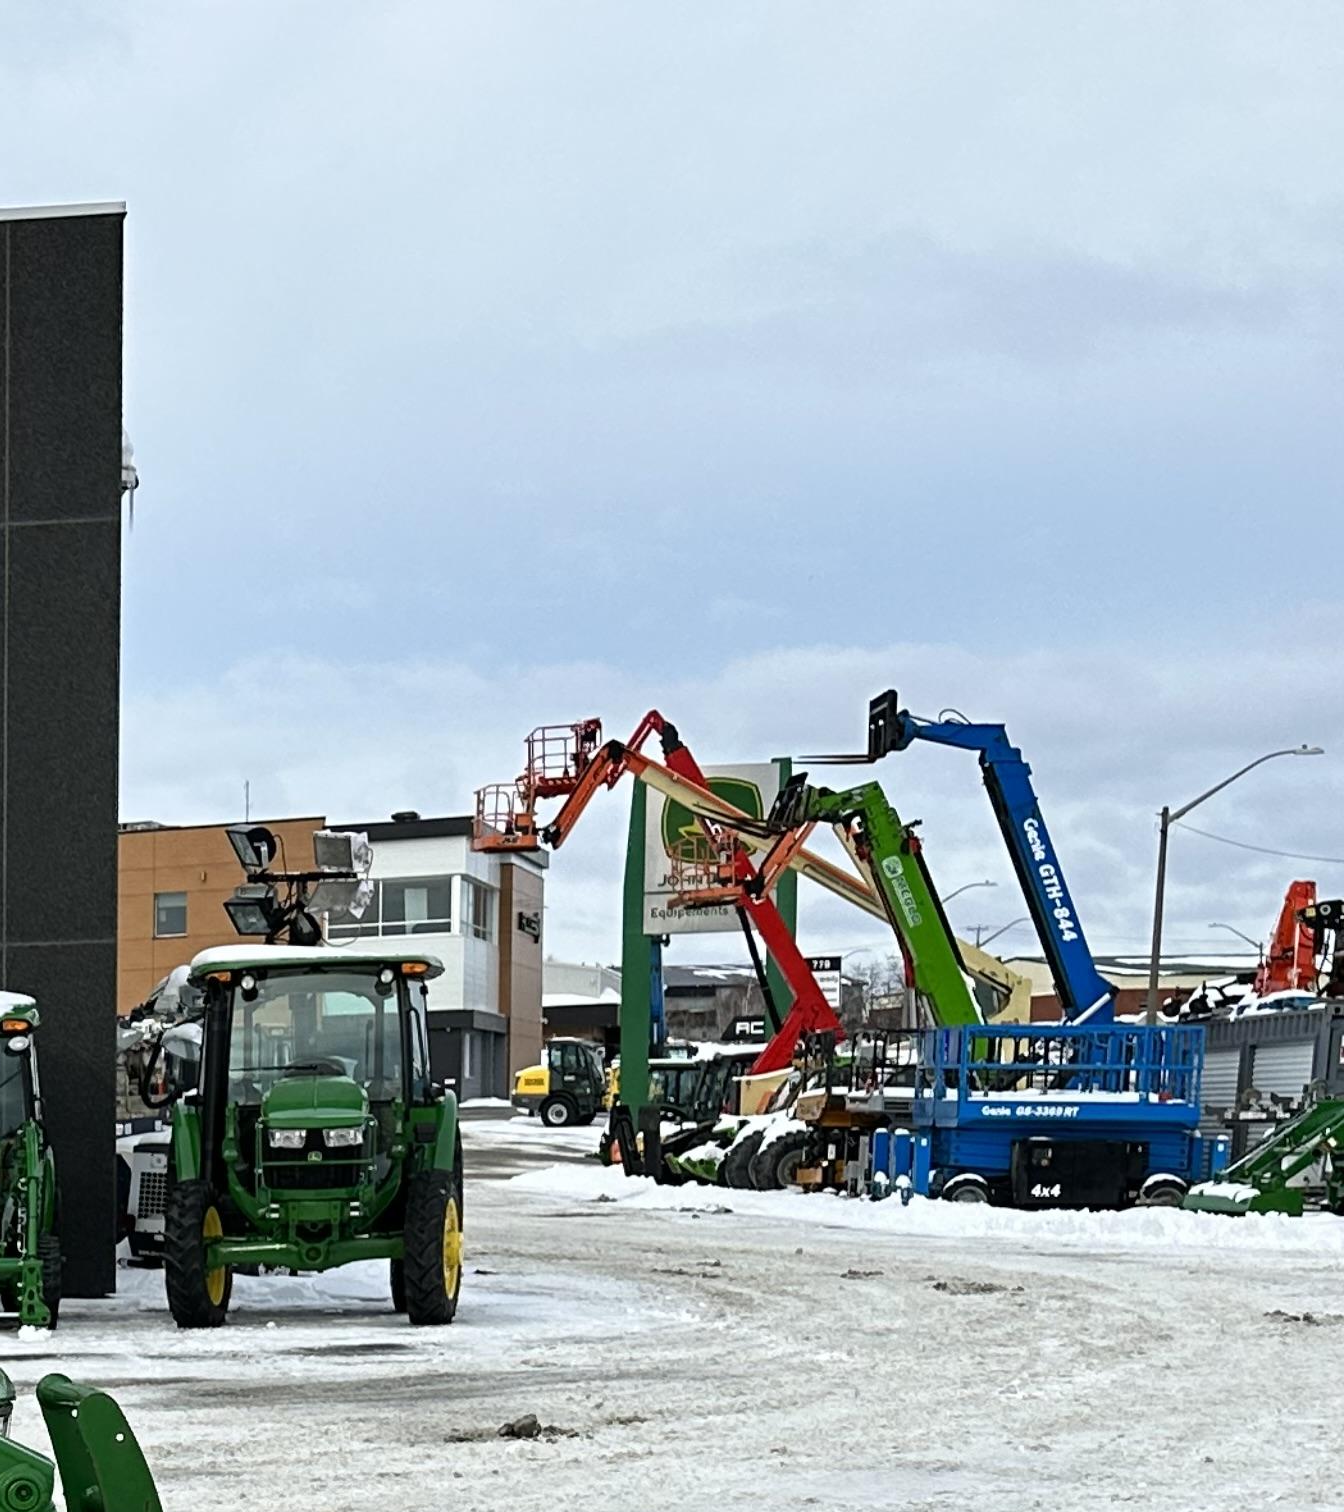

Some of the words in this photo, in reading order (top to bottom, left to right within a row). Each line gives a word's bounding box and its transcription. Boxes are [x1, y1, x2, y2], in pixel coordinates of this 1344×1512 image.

[1024, 818, 1046, 861] Genie
[1039, 864, 1078, 941] GTH-844
[1031, 1183, 1061, 1198] 4x4
